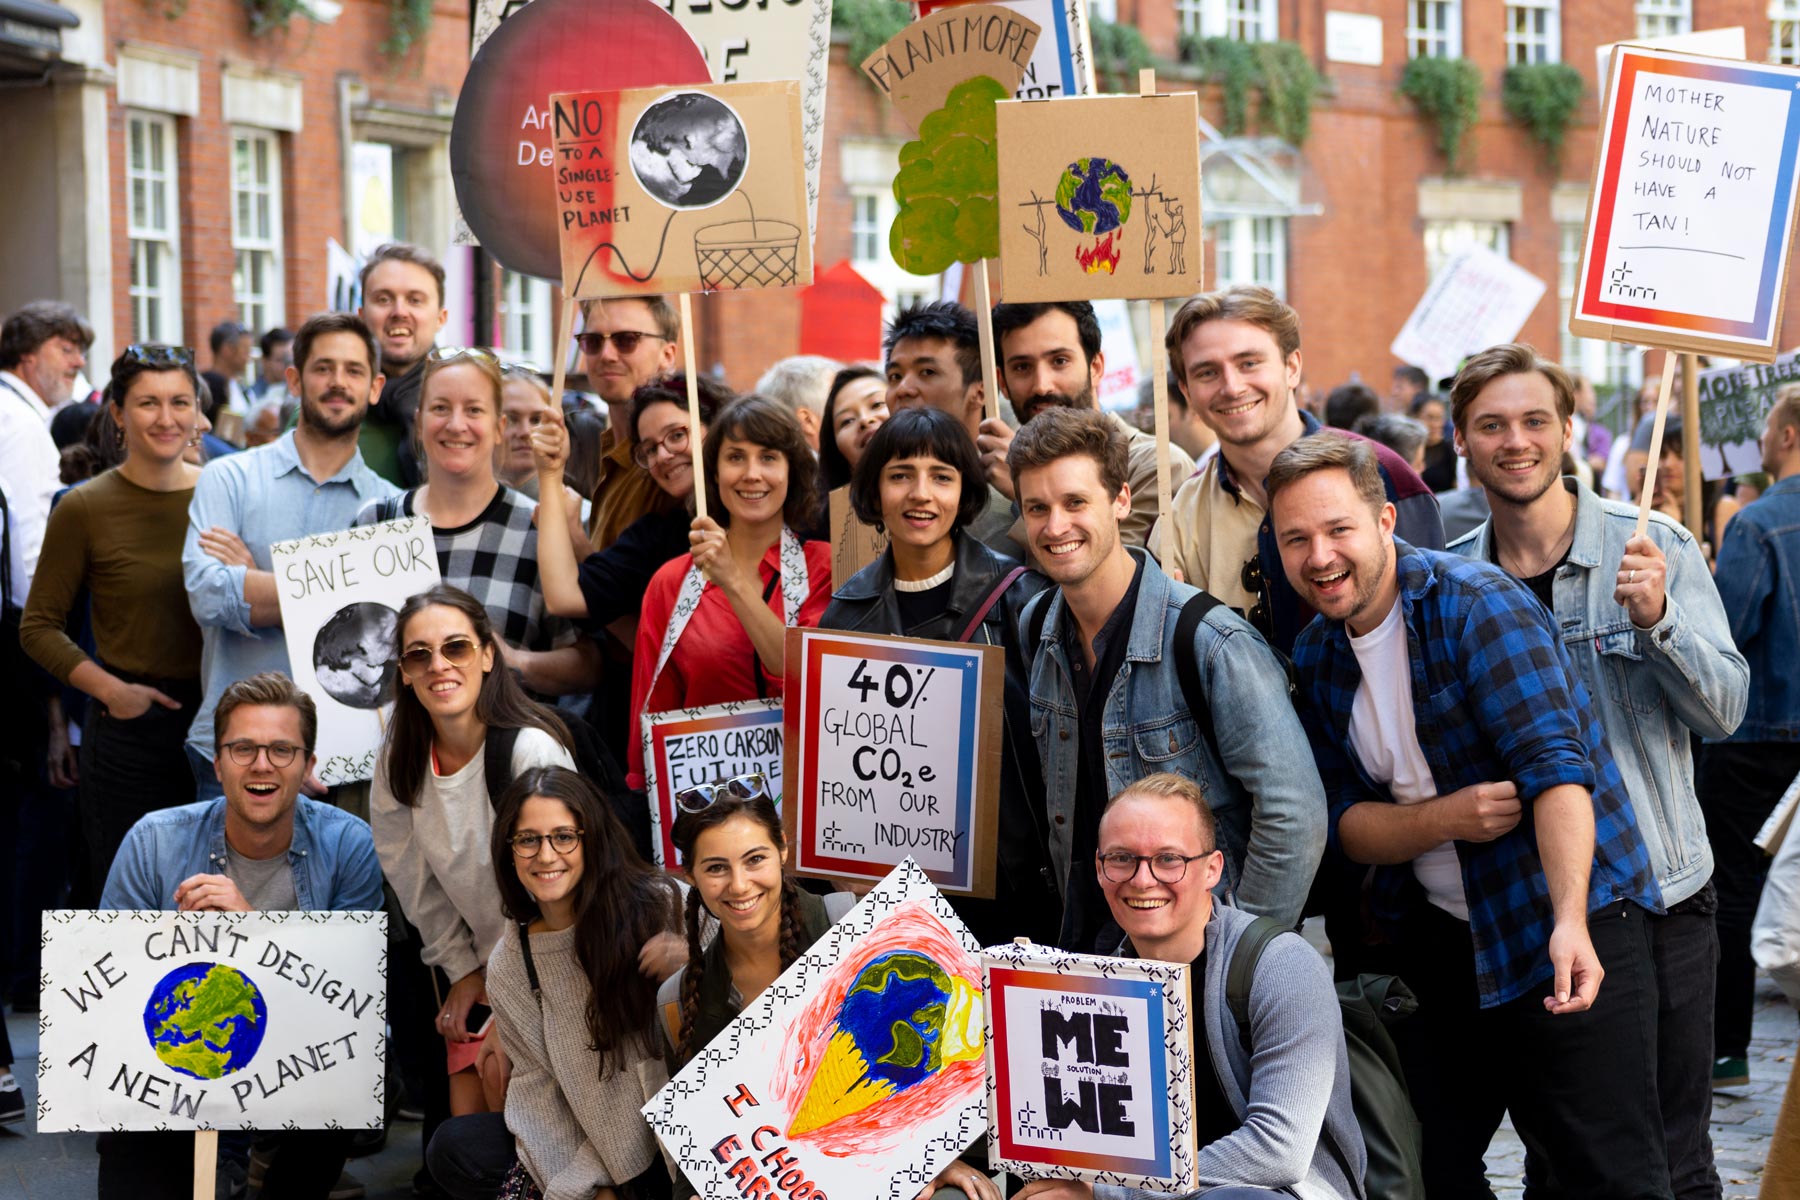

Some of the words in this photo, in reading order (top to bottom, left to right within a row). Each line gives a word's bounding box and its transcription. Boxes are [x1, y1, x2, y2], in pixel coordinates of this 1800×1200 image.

[868, 18, 957, 92] PLANT
[963, 15, 1037, 69] MORE
[1644, 84, 1725, 113] MOTHER
[554, 99, 603, 138] NO
[1641, 115, 1722, 147] NATURE
[559, 147, 583, 161] TO
[588, 146, 603, 160] A
[1638, 150, 1702, 174] SHOULD
[1721, 161, 1757, 181] NOT
[559, 190, 596, 204] USE
[1634, 181, 1677, 199] HAVE
[1703, 185, 1717, 200] A
[562, 206, 631, 231] PLANET
[286, 552, 360, 600] SAVE
[373, 537, 433, 578] OUR
[848, 659, 936, 709] 40%
[666, 735, 719, 761] ZERO
[724, 727, 783, 759] CARBON
[824, 707, 928, 748] GLOBAL
[821, 781, 877, 814] FROM
[899, 791, 940, 817] OUR
[875, 822, 965, 859] INDUSTRY
[61, 951, 127, 1014] WE
[144, 924, 249, 960] CAN'T
[257, 941, 374, 1019] DESIGN
[1061, 995, 1097, 1007] PROBLEM
[1041, 1009, 1130, 1068] ME
[68, 1041, 99, 1080] A
[108, 1063, 207, 1120] NEW
[231, 1031, 358, 1113] PLANET
[1066, 1065, 1102, 1076] SOLUTION
[722, 1083, 760, 1118] I
[1043, 1076, 1136, 1138] WE
[710, 1134, 780, 1200] EAR
